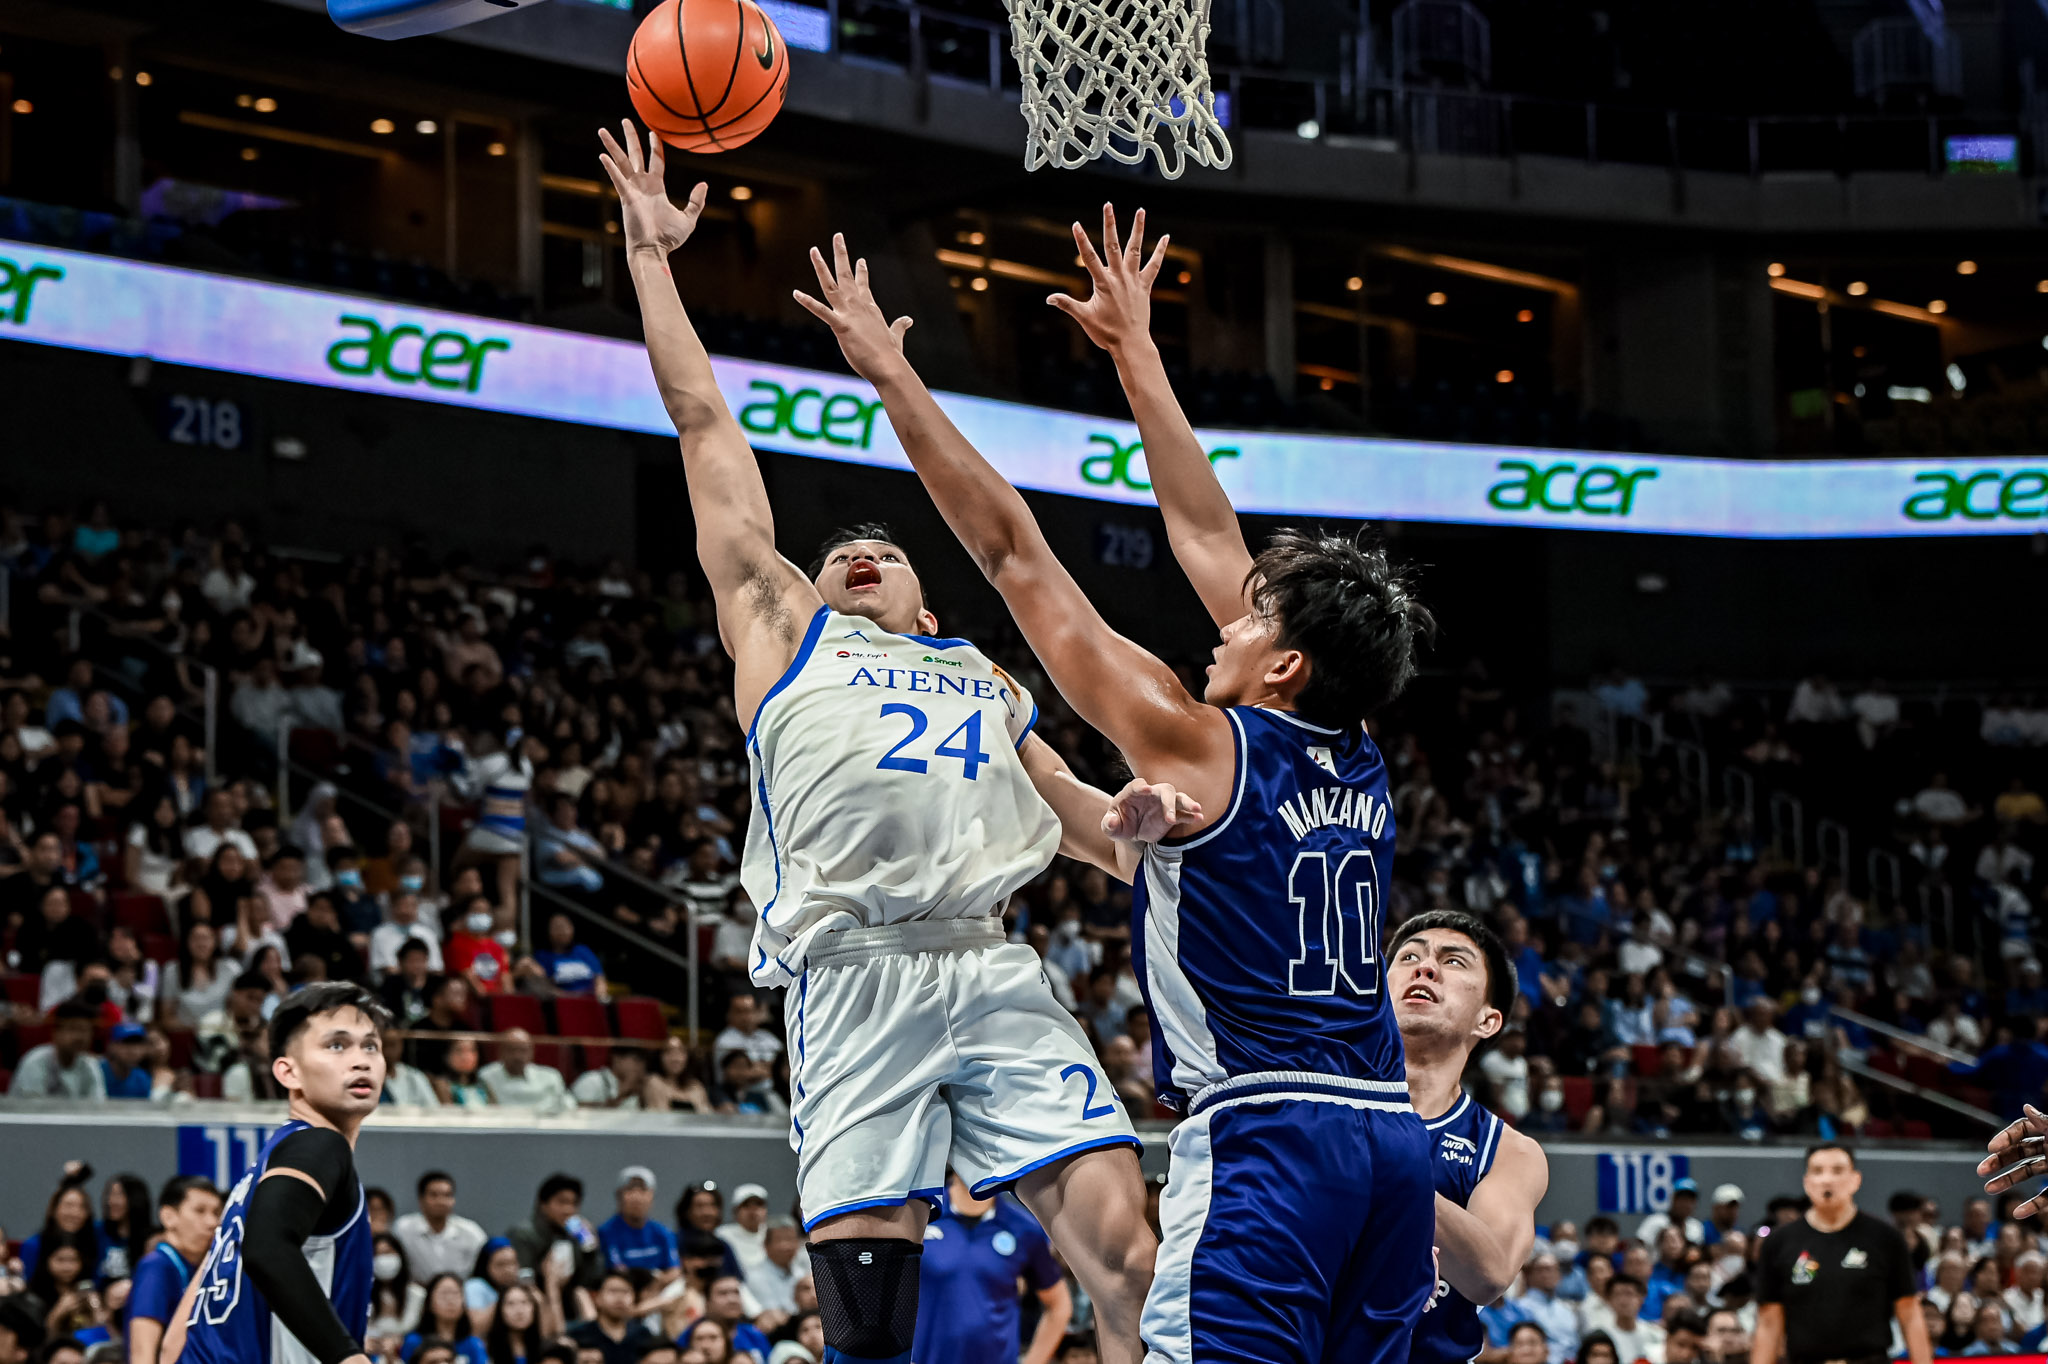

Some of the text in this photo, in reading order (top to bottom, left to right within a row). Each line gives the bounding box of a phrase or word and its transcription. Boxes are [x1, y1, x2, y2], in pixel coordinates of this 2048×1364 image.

[326, 315, 510, 394] acer
[170, 395, 242, 450] 218
[739, 380, 884, 449] acer
[1487, 461, 1658, 516] acer
[1902, 471, 2048, 522] ace
[1101, 522, 1154, 569] 219
[934, 656, 963, 668] Smart
[847, 666, 1015, 718] ATENEO
[876, 702, 990, 781] 24
[1278, 787, 1387, 842] MANZANO
[1288, 850, 1380, 996] 10
[1060, 1063, 1121, 1120] 2
[204, 1129, 274, 1191] 11
[1441, 1139, 1465, 1151] ANTA
[1611, 1152, 1674, 1213] 118
